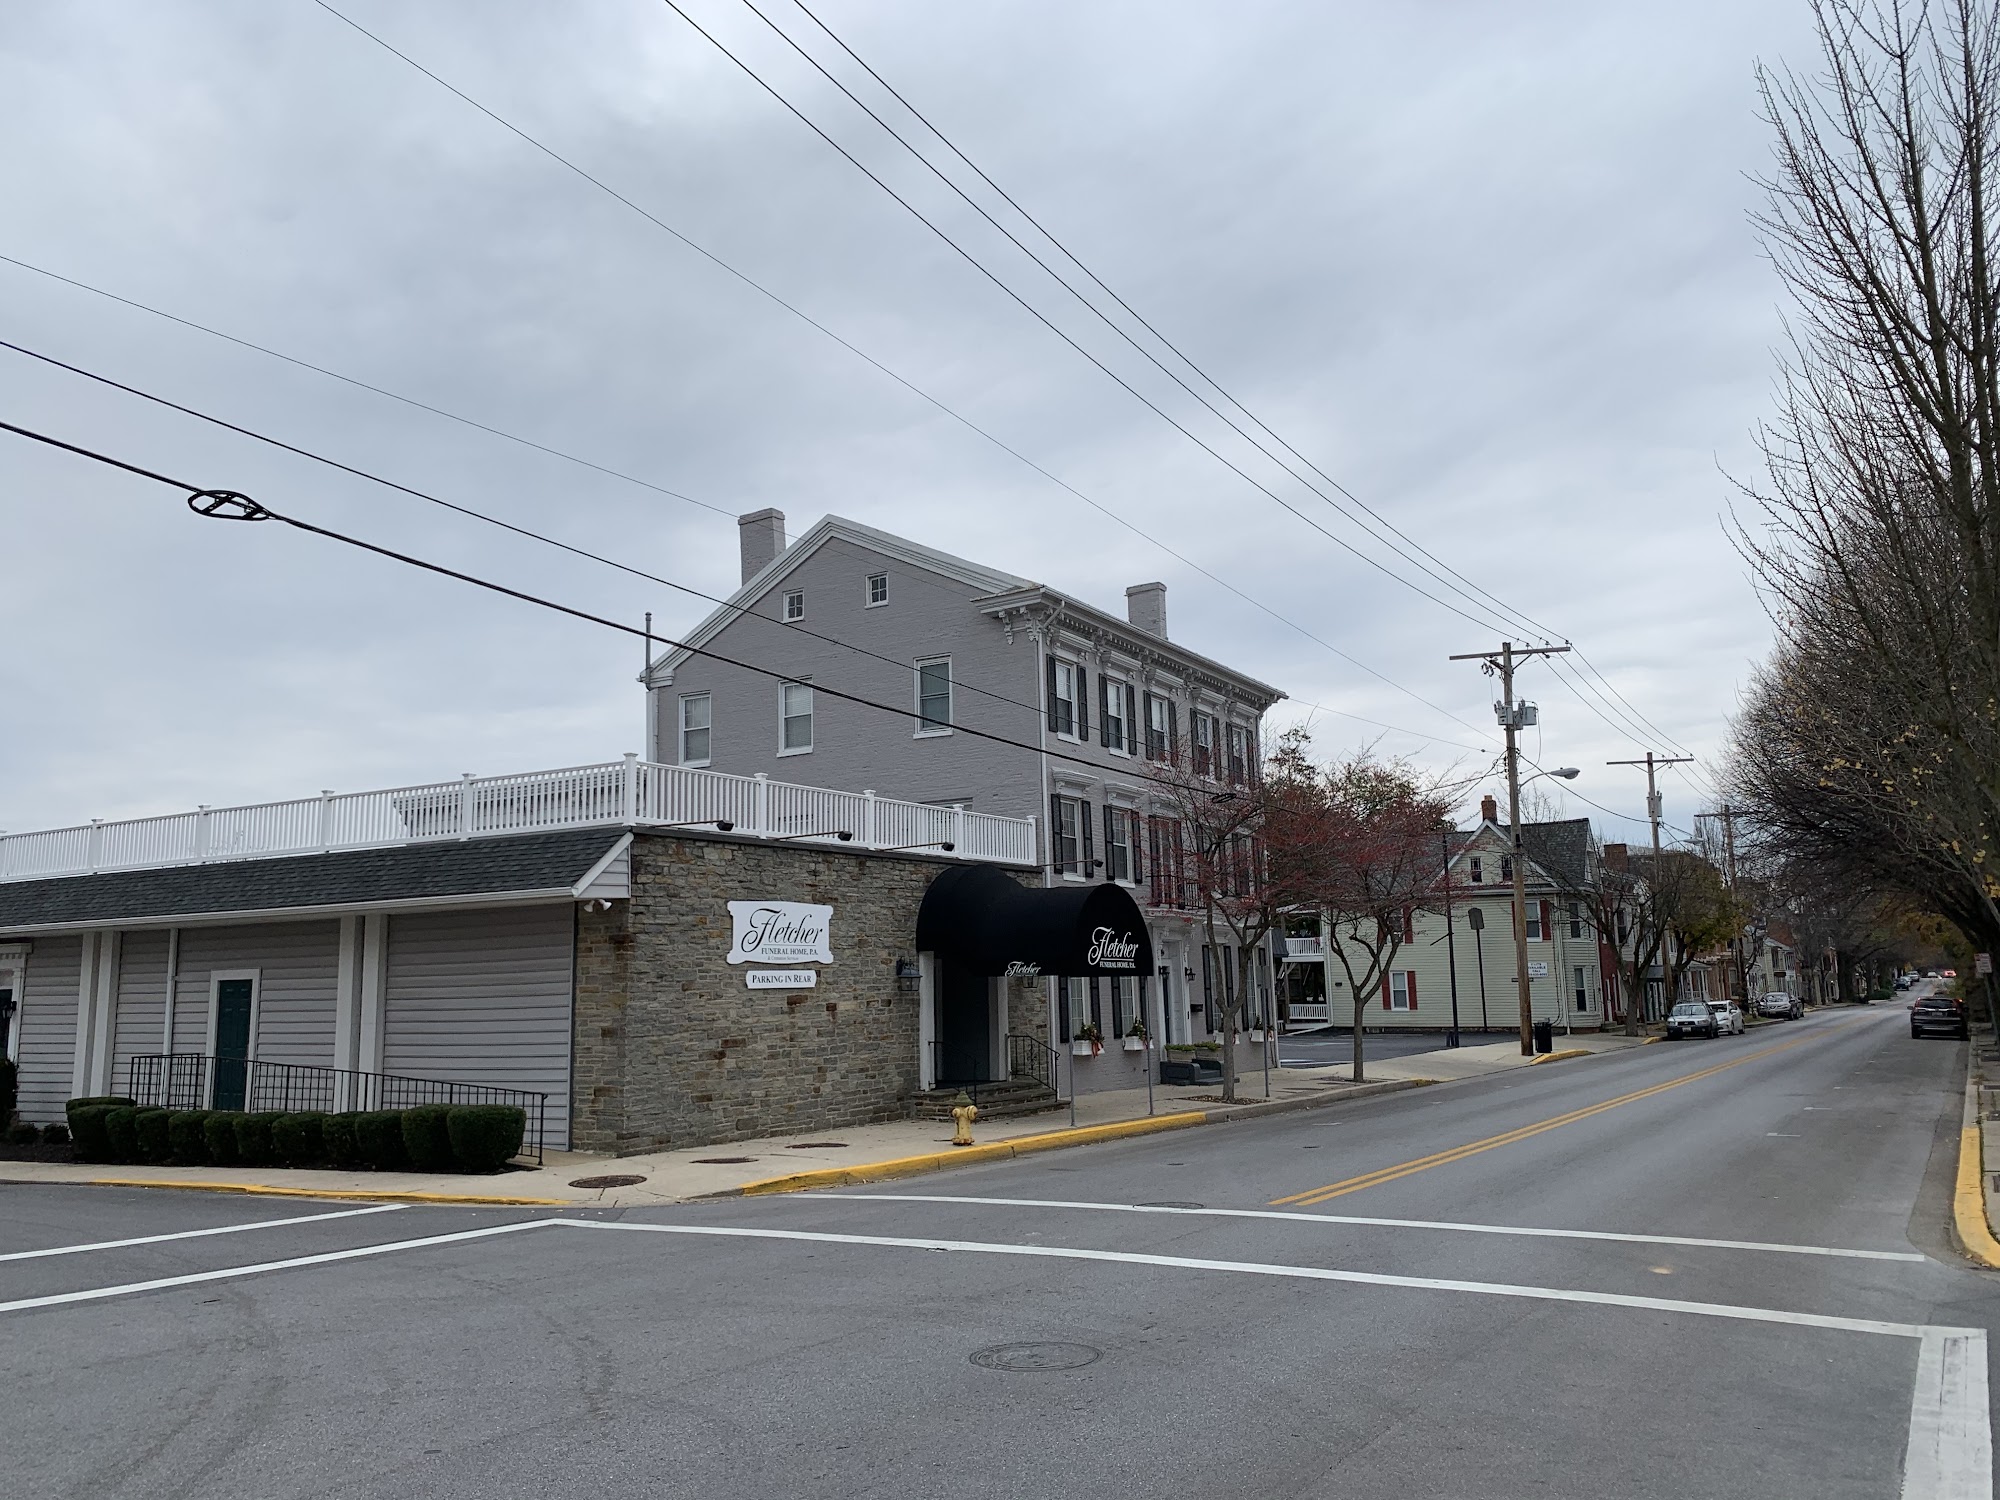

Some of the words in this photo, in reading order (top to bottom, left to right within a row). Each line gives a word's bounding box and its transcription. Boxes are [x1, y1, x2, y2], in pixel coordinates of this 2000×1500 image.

[741, 908, 823, 953] Fletcher
[1088, 927, 1138, 965] Fletcher
[752, 974, 783, 983] PARKING
[785, 975, 792, 983] IN
[793, 974, 812, 983] REAR
[1005, 961, 1041, 977] Fletcher
